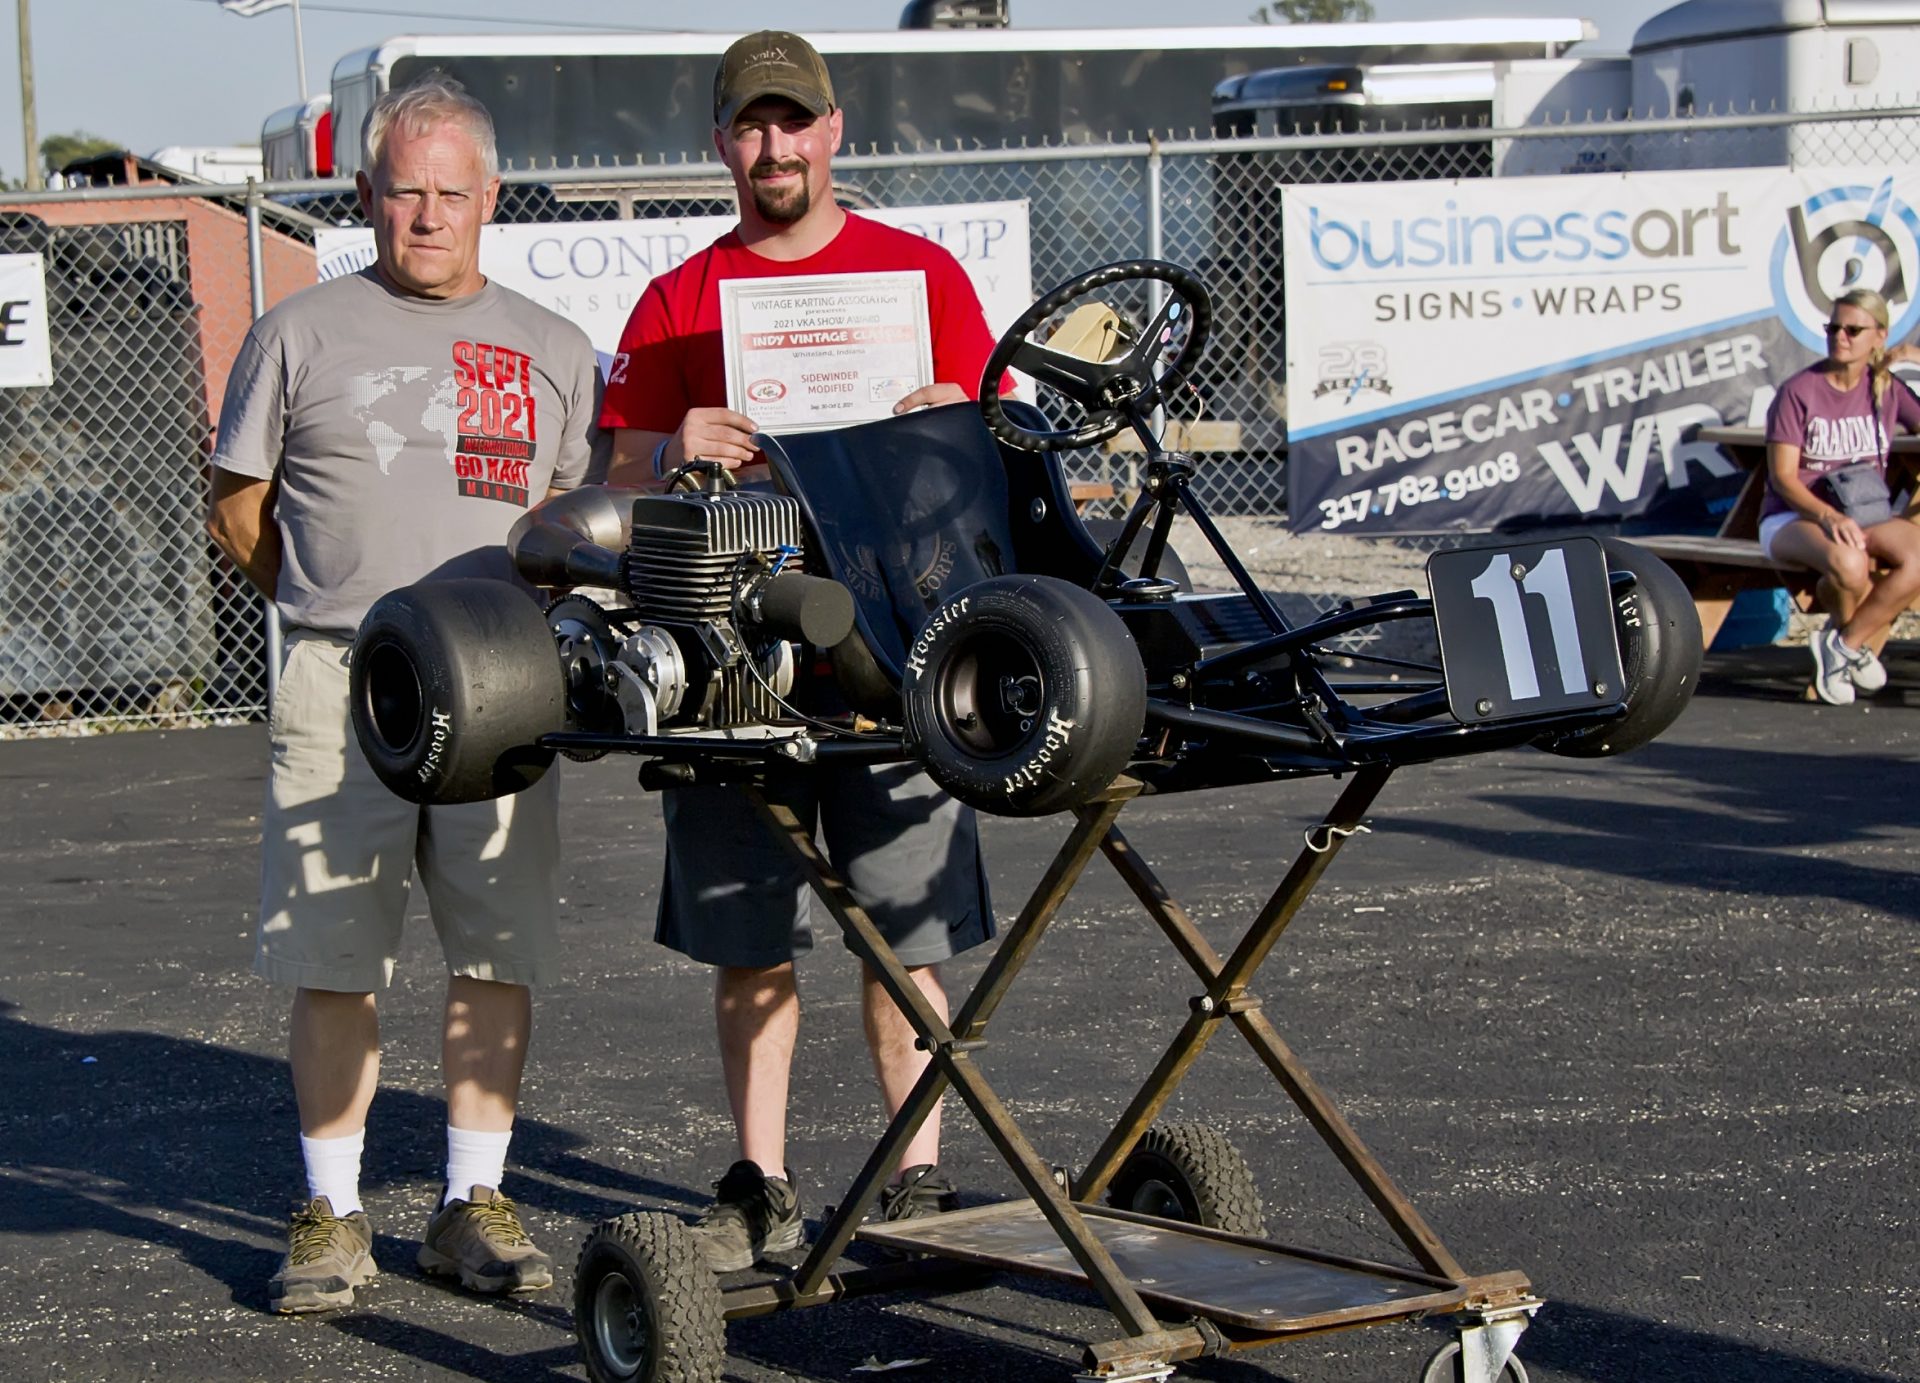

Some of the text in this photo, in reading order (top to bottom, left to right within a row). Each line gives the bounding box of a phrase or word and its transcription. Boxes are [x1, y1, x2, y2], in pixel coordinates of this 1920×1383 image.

[1309, 191, 1741, 271] businessart
[527, 233, 692, 281] CONR
[751, 299, 793, 311] VINTAGE
[794, 296, 835, 308] KARTING
[796, 318, 815, 328] VKA
[817, 316, 847, 327] SHOW
[1375, 283, 1683, 322] SIGNS WRAPS
[752, 335, 785, 347] INDY
[789, 330, 849, 345] VINTAGE
[452, 340, 535, 398] SEPT
[807, 384, 854, 395] MODIFIED
[1573, 334, 1768, 414] TRAILER
[456, 387, 537, 442] 2021
[455, 454, 532, 489] GO KART
[464, 438, 530, 458] INTERNATIONAL
[466, 481, 526, 506] MONTH
[916, 540, 957, 599] CORPS
[907, 596, 970, 681] Hoosier
[1470, 548, 1589, 700] 11
[417, 705, 454, 784] Hoosier
[1004, 705, 1078, 795] Hoosier
